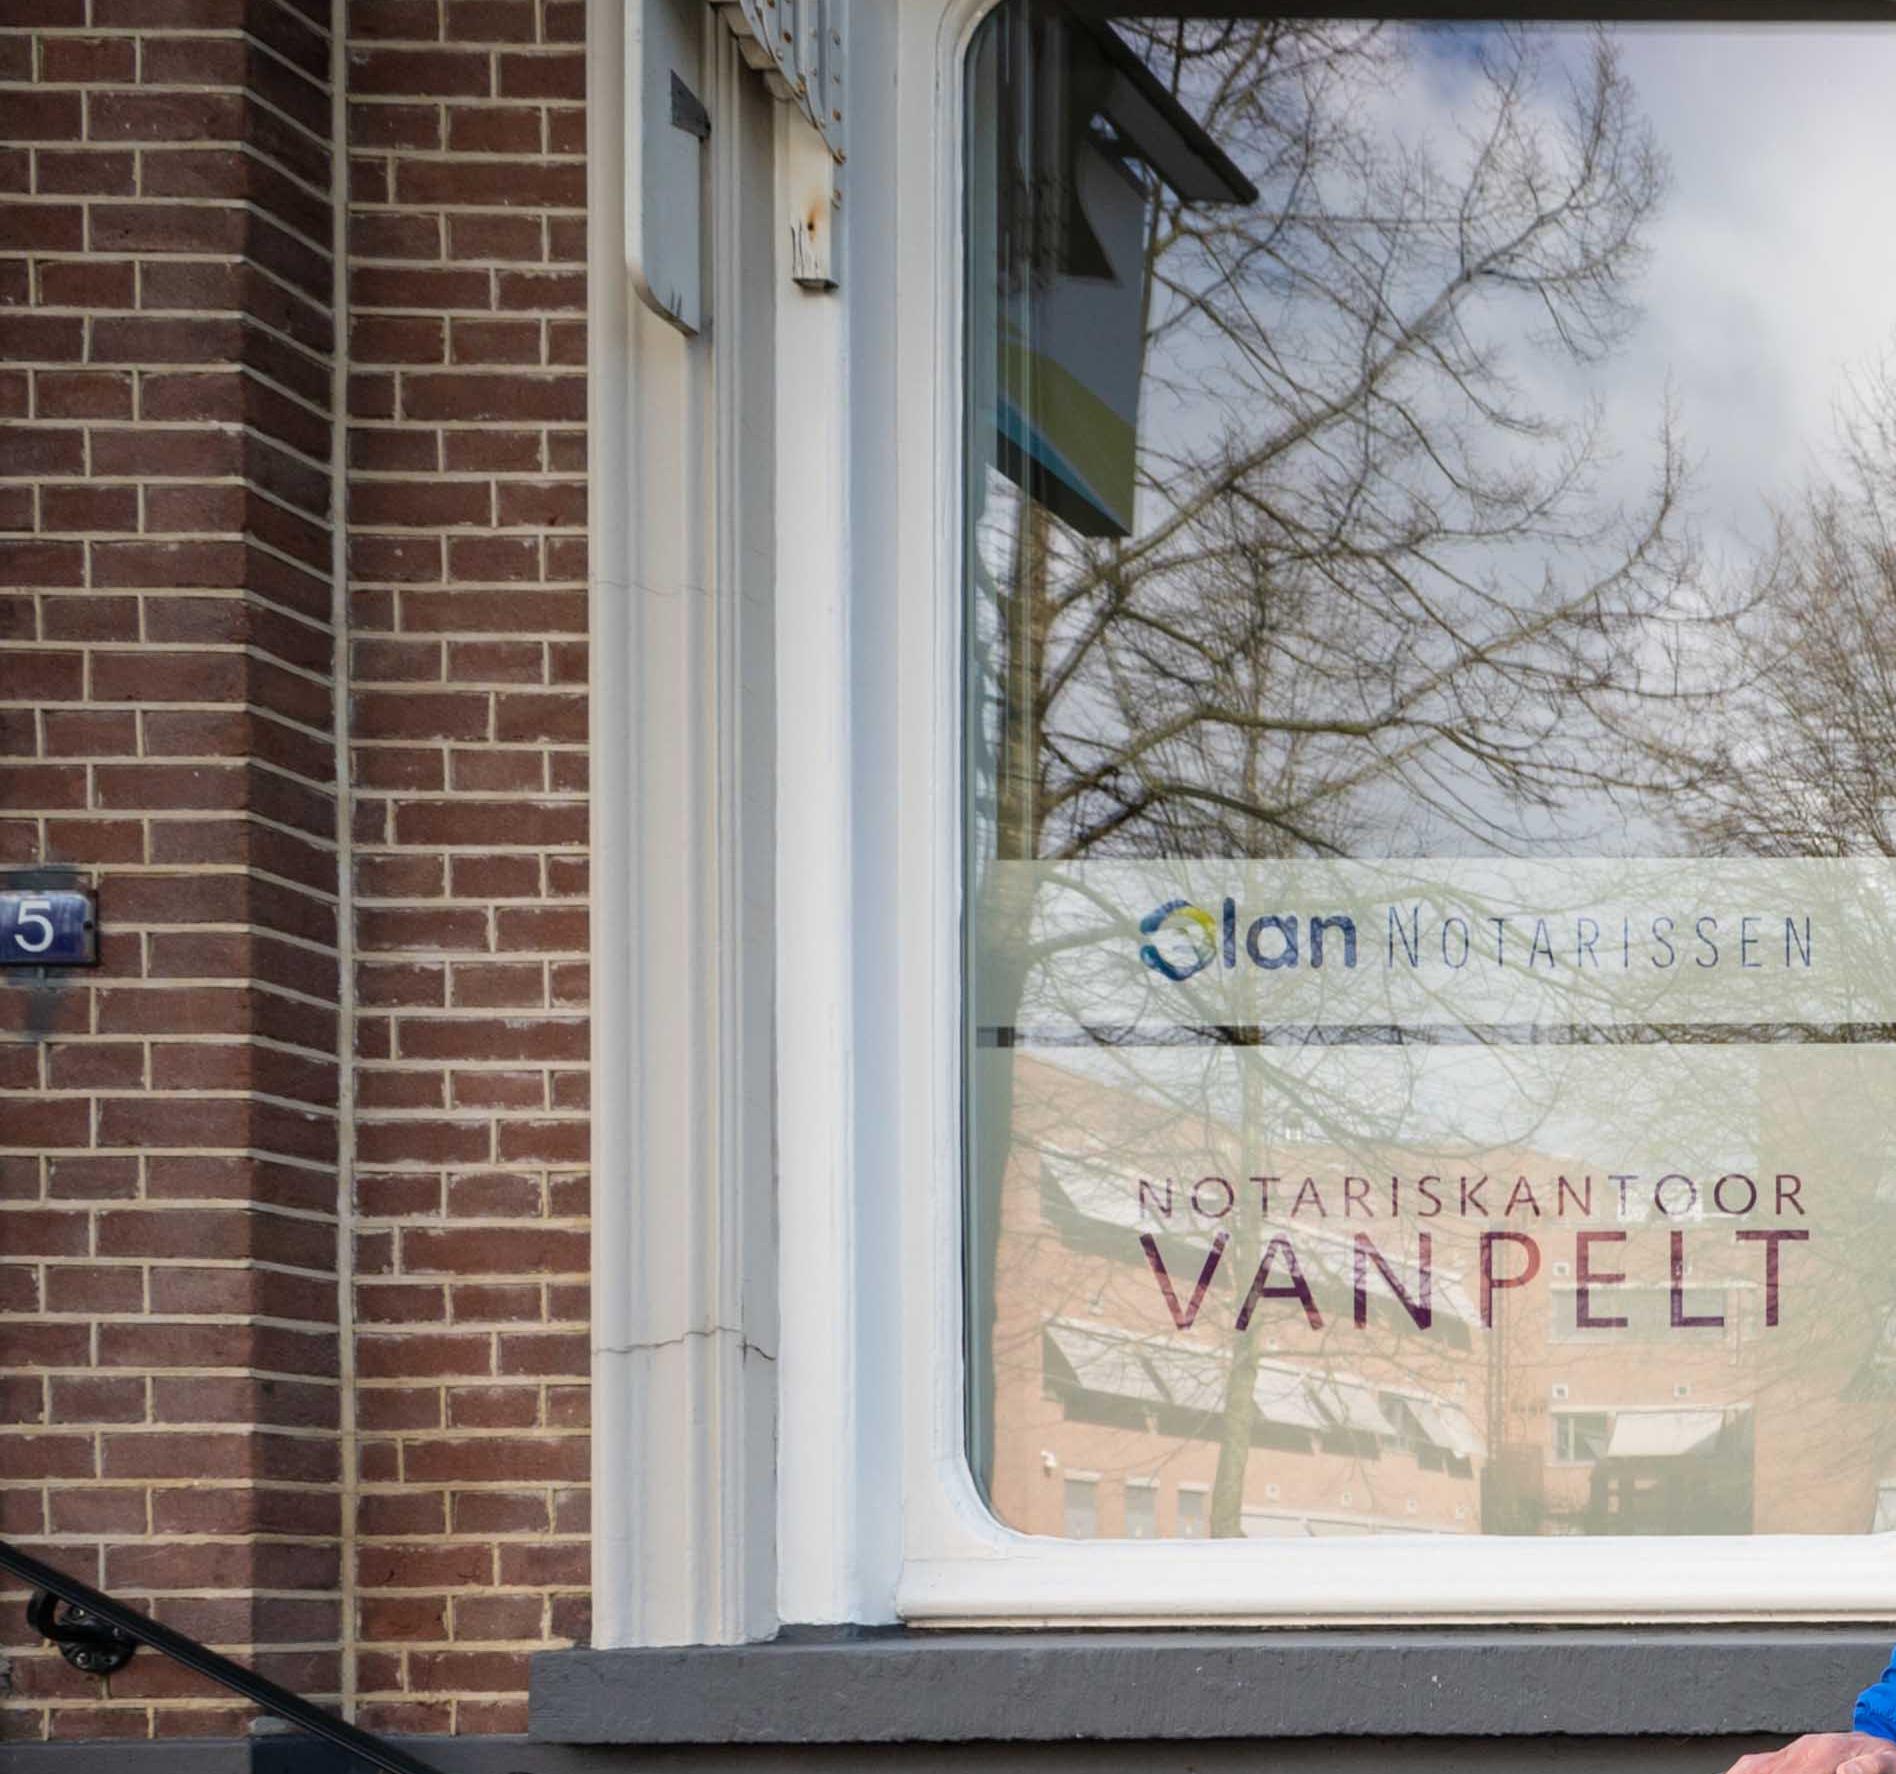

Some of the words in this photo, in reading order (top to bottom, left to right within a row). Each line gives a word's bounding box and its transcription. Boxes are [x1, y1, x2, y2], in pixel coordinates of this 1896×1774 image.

[14, 900, 54, 952] 5
[1388, 905, 1813, 968] NOTARISSEN
[1137, 1173, 1806, 1219] NOTARISKANTOOR
